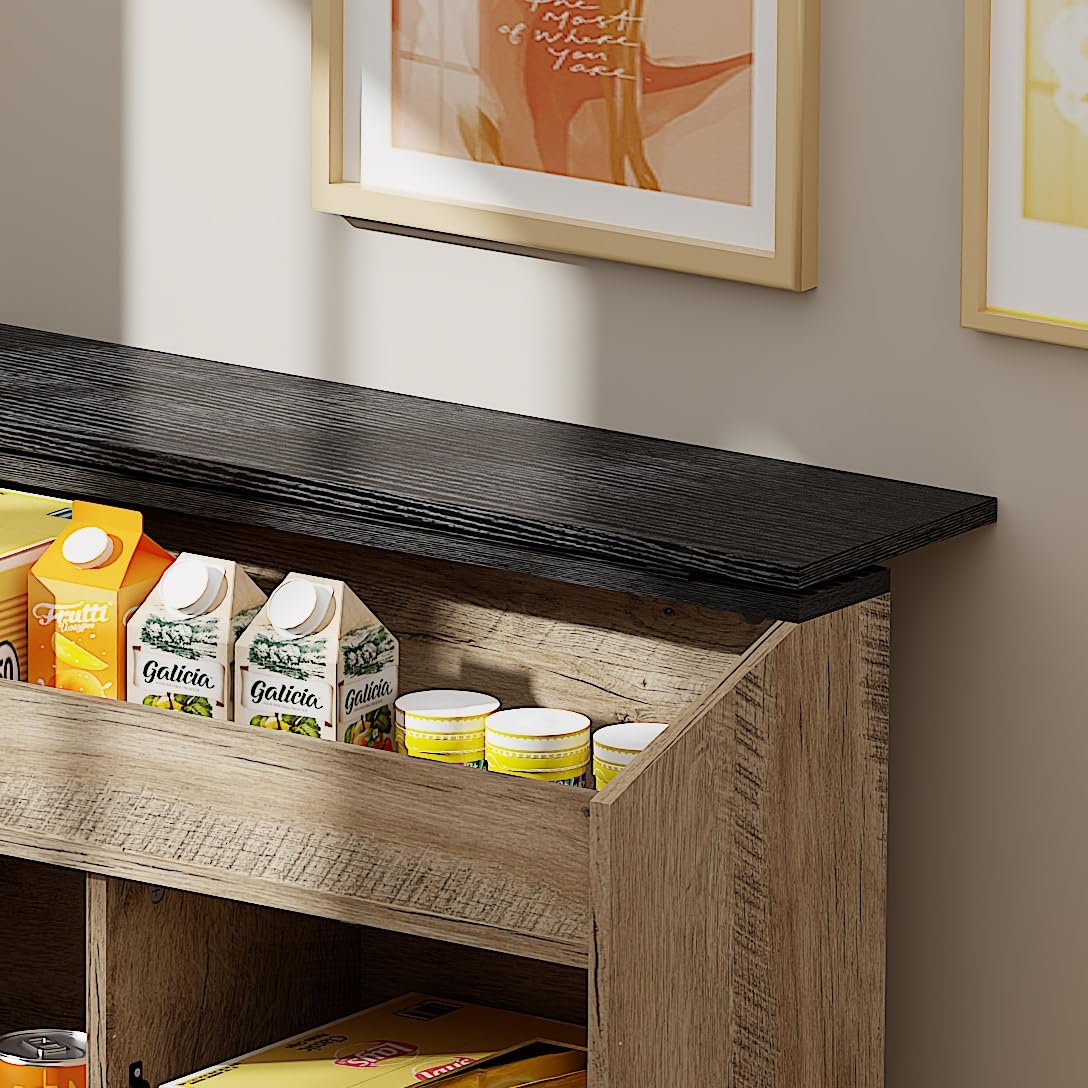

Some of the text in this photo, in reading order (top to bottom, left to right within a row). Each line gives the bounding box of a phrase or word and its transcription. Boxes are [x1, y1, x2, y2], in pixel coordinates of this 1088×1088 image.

[32, 600, 110, 626] Frutti
[143, 660, 215, 689] Galicia
[250, 680, 324, 710] Galicia
[345, 678, 393, 715] Galicia
